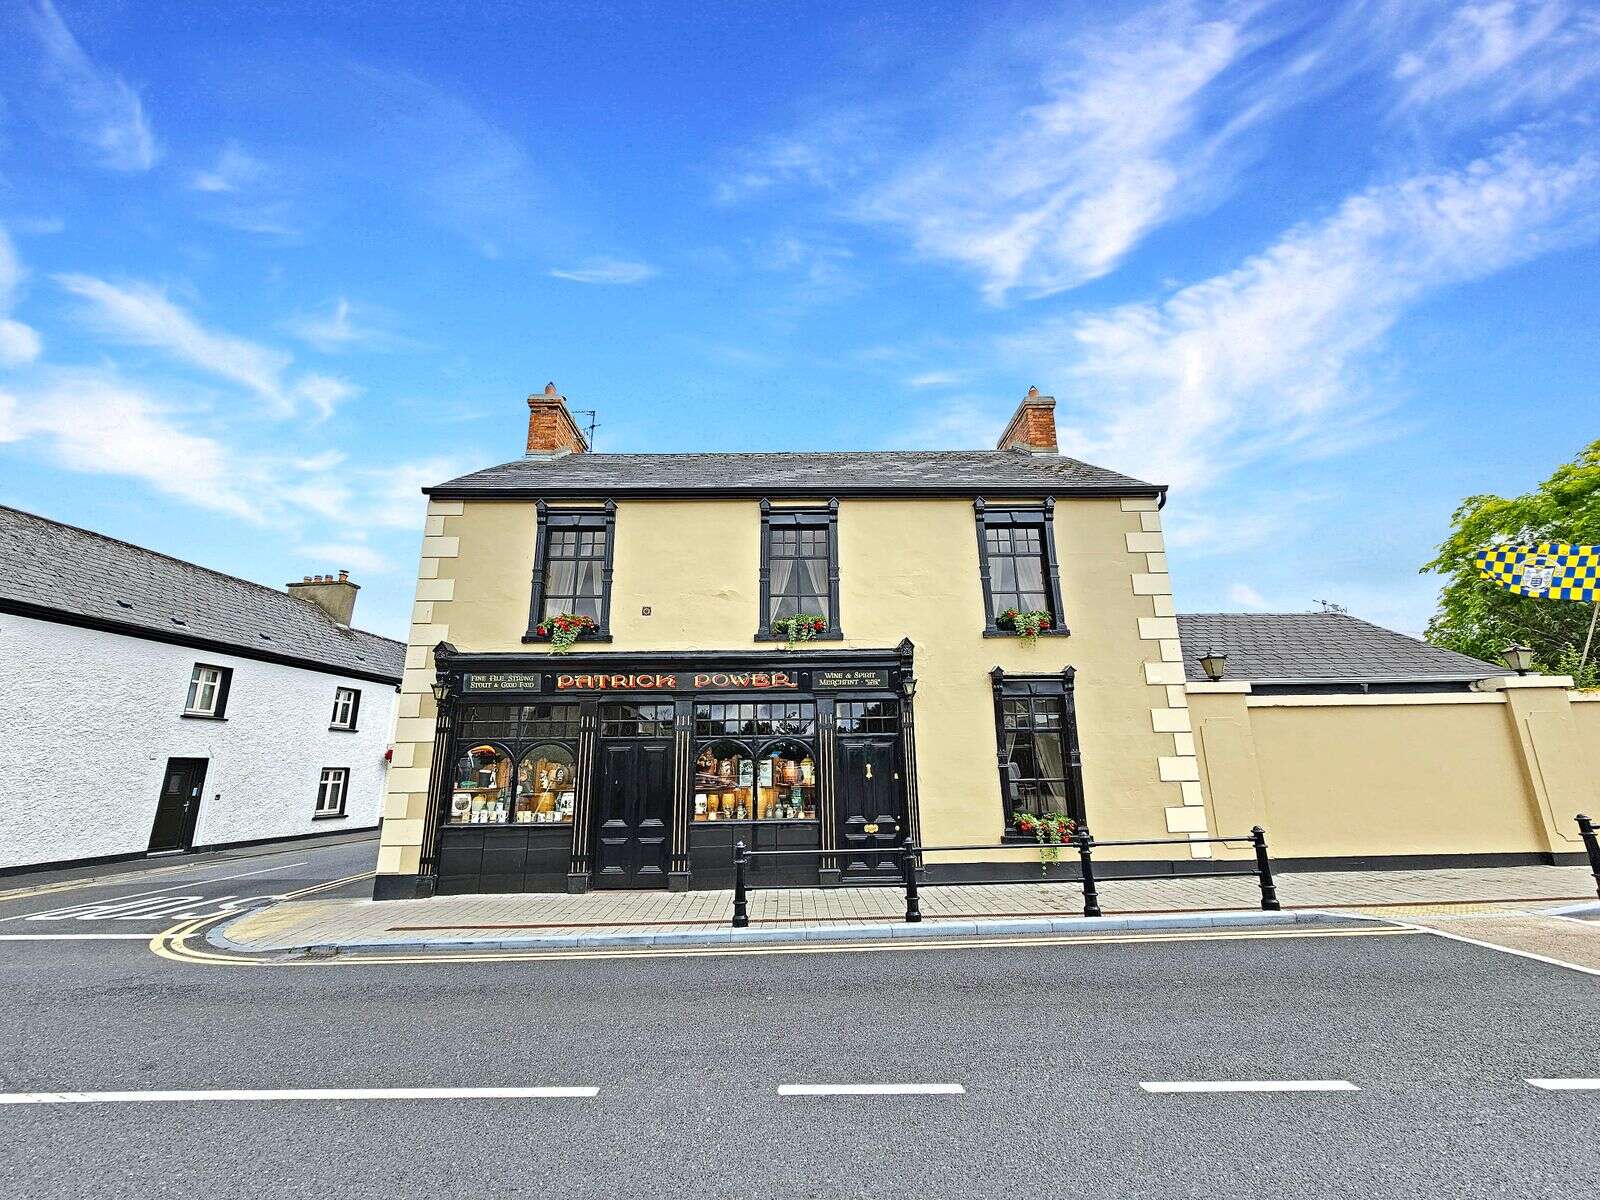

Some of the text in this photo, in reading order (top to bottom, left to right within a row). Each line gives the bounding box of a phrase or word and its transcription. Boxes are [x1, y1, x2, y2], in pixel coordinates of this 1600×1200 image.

[824, 671, 843, 679] WINE
[853, 671, 877, 679] SPIRIT
[470, 681, 492, 689] STOUT
[500, 681, 518, 689] GOOD
[556, 672, 799, 690] PATRICK POWER
[819, 679, 859, 687] MERCHANT
